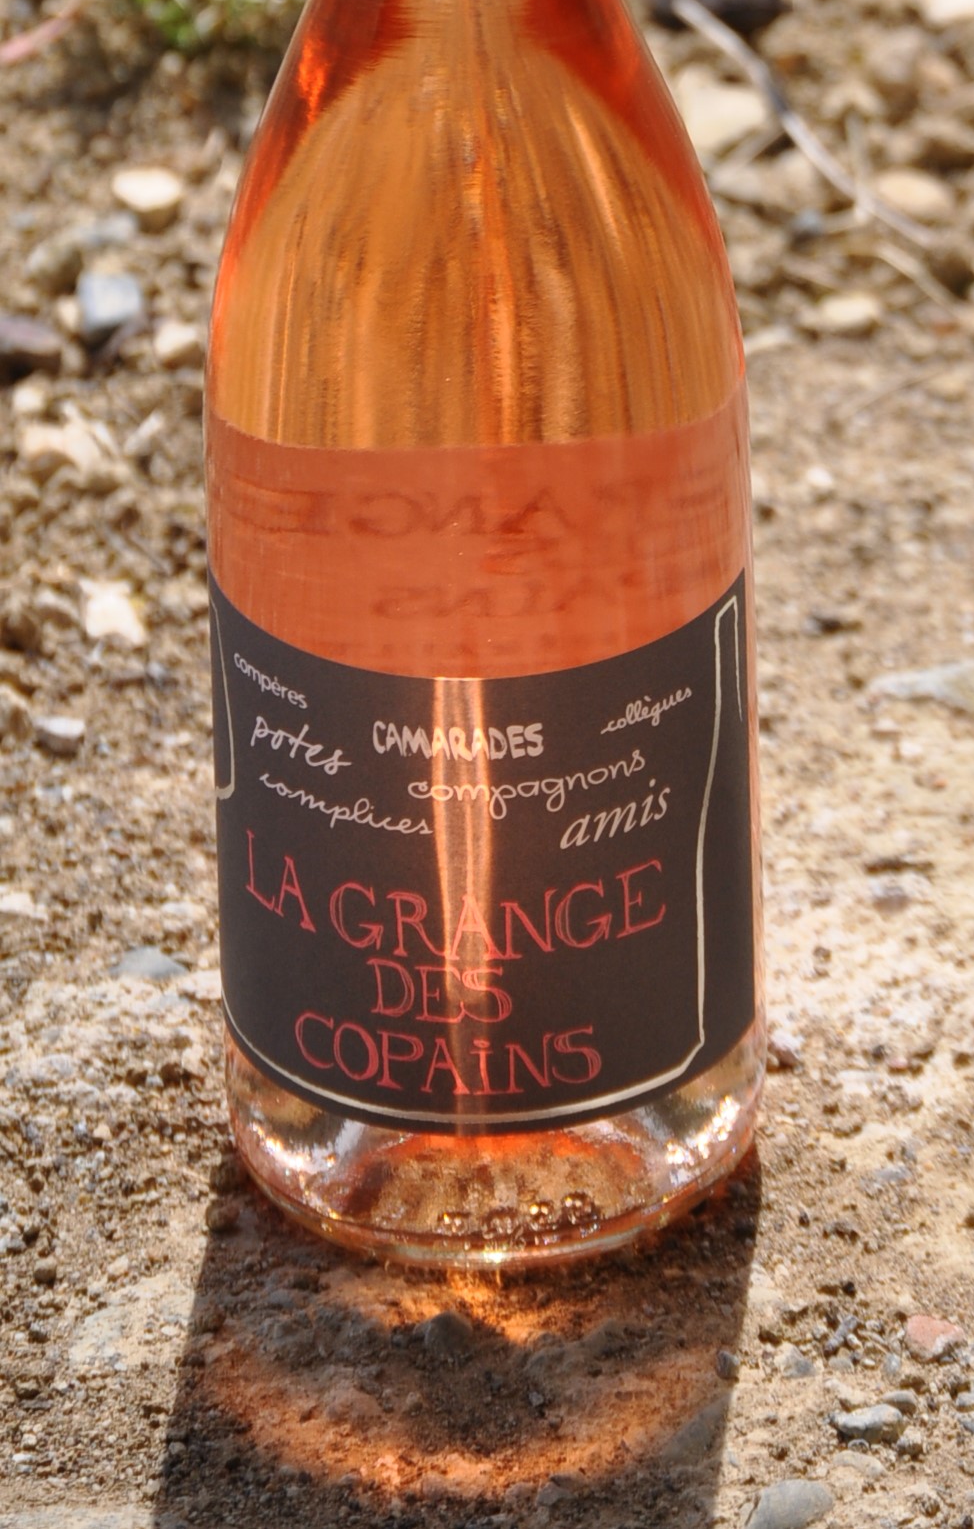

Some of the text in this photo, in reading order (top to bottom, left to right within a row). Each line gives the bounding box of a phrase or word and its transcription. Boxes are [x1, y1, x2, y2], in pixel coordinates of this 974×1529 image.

[233, 652, 309, 710] compères
[600, 686, 693, 733] collègues
[250, 715, 352, 776] potes
[371, 720, 545, 762] CAMARADES
[258, 772, 434, 835] complices
[407, 749, 646, 821] compagnons
[559, 778, 671, 851] amis
[245, 828, 667, 961] LA GRANGE
[366, 957, 513, 1023] DES
